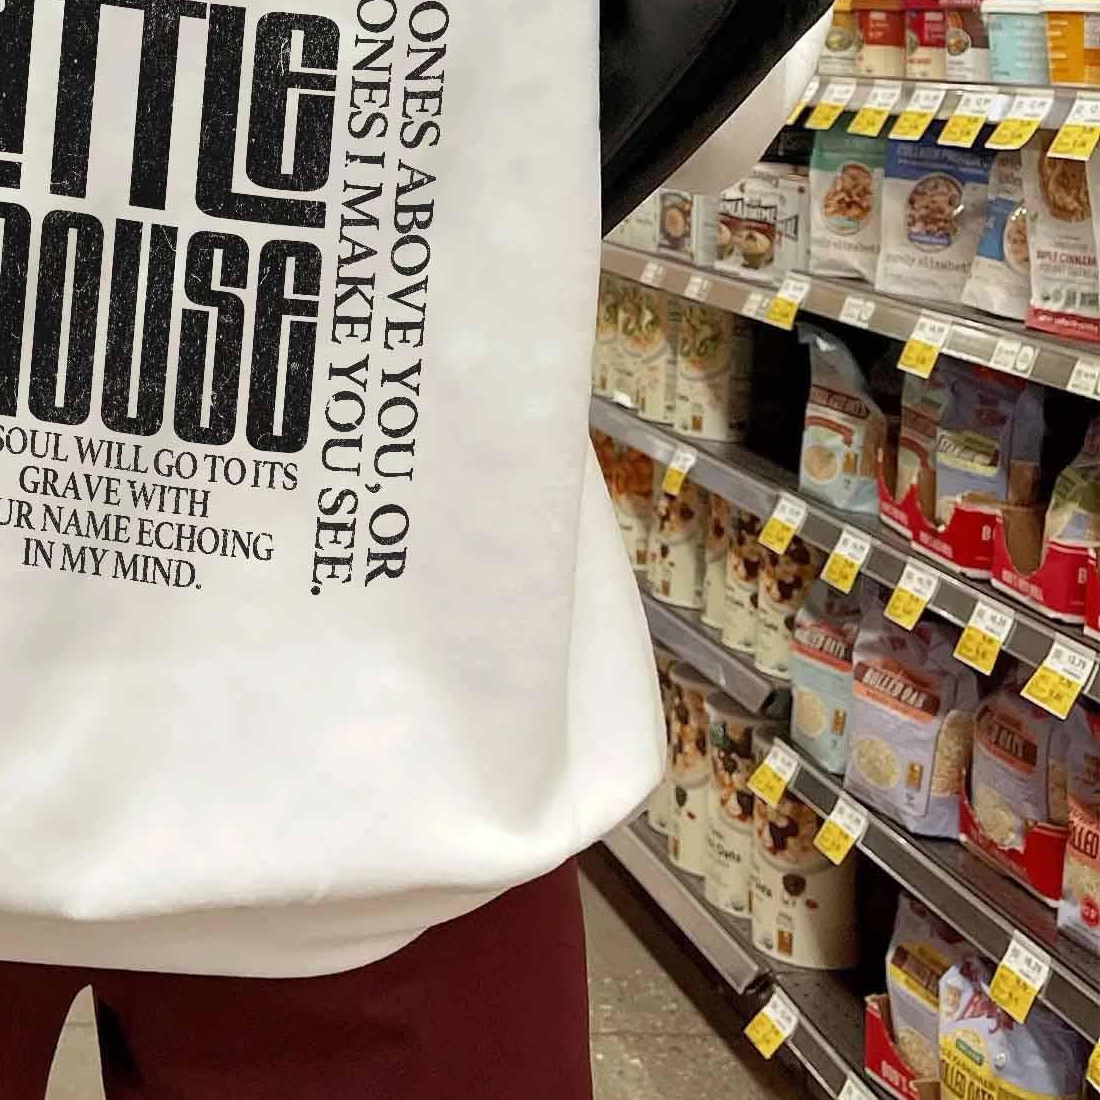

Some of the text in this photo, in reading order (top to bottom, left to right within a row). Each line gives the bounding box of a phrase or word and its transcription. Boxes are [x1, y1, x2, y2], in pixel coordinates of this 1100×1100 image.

[399, 0, 450, 150] ONES
[345, 150, 386, 169] I
[331, 179, 384, 345] MAKE
[383, 158, 438, 351] ABOVE
[74, 435, 149, 475] WILL
[154, 448, 198, 480] GO
[204, 453, 247, 486] TO
[251, 459, 298, 491] ITS
[321, 353, 370, 477] YOU
[364, 358, 422, 495] YOU,
[19, 465, 211, 519] GRAVE WITH
[40, 503, 131, 544] NAME
[135, 517, 275, 562] ECHOING
[21, 537, 203, 591] IN MY MIND.
[310, 487, 359, 596] SEE.
[364, 504, 410, 588] OR
